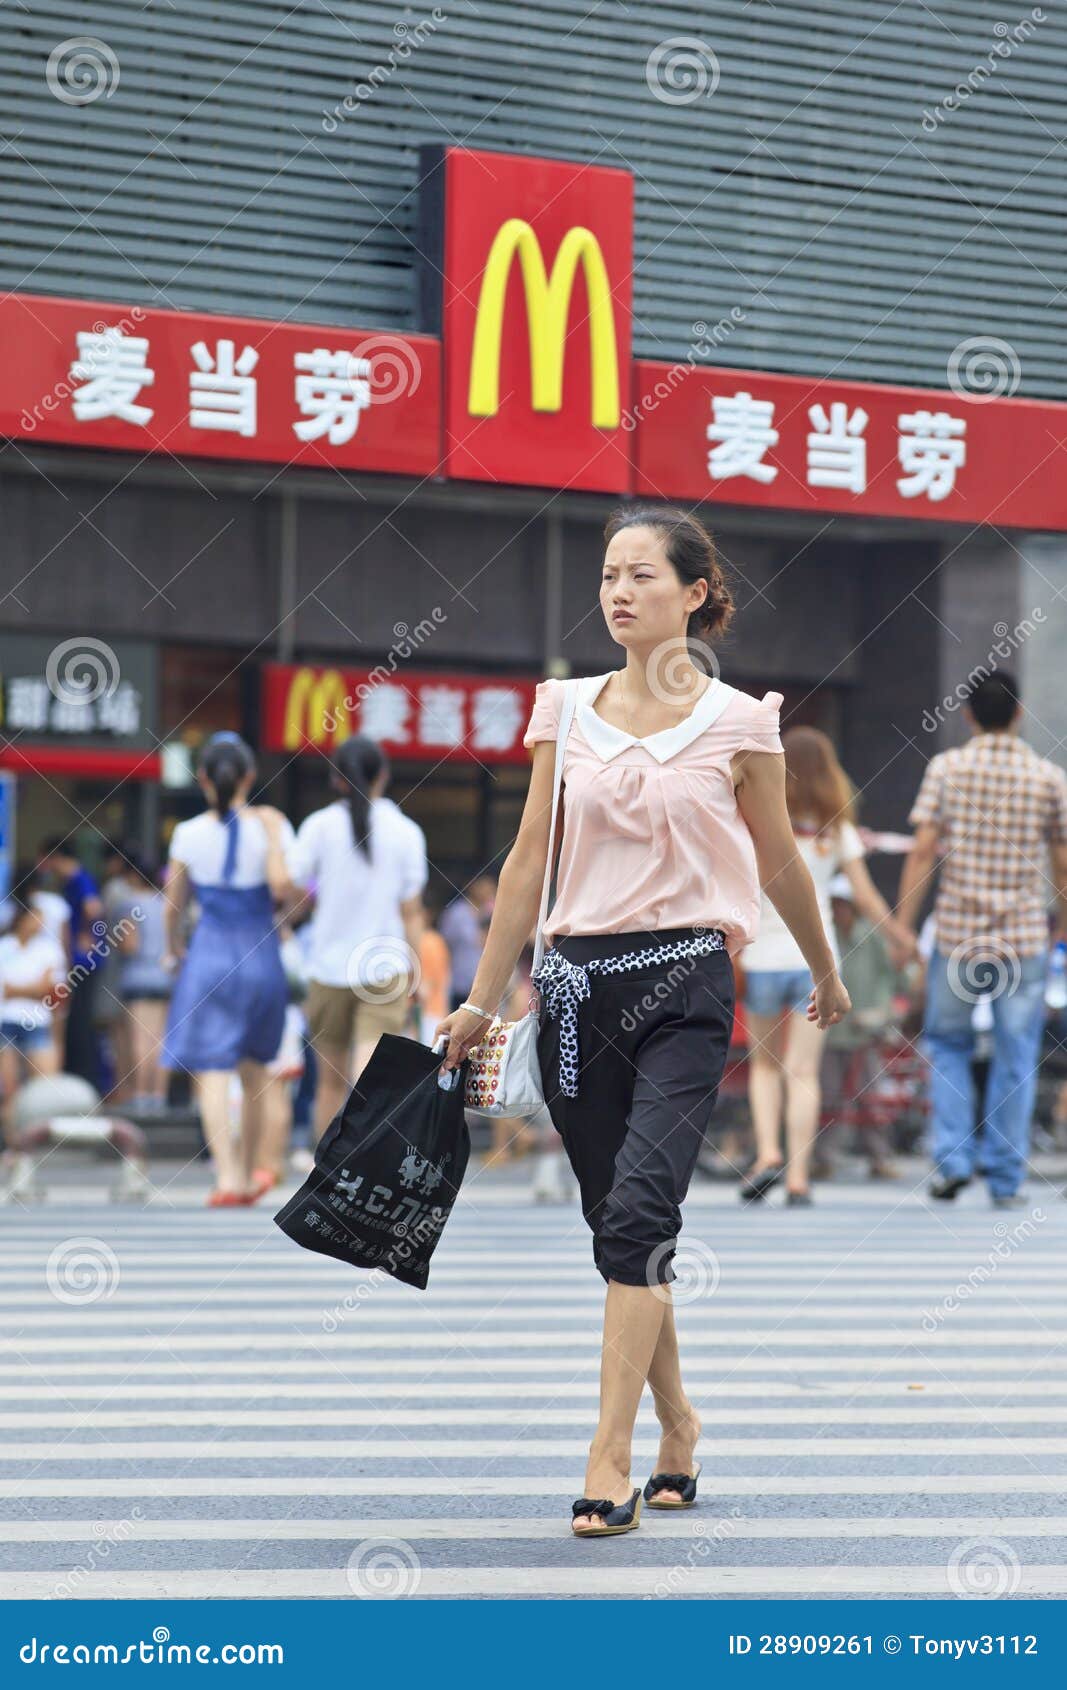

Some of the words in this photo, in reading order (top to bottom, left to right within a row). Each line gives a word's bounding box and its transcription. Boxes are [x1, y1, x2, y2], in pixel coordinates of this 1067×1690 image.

[469, 218, 619, 429] M
[71, 327, 372, 446] 麦当劳
[706, 391, 966, 502] 麦当劳
[360, 683, 524, 753] 麦当劳
